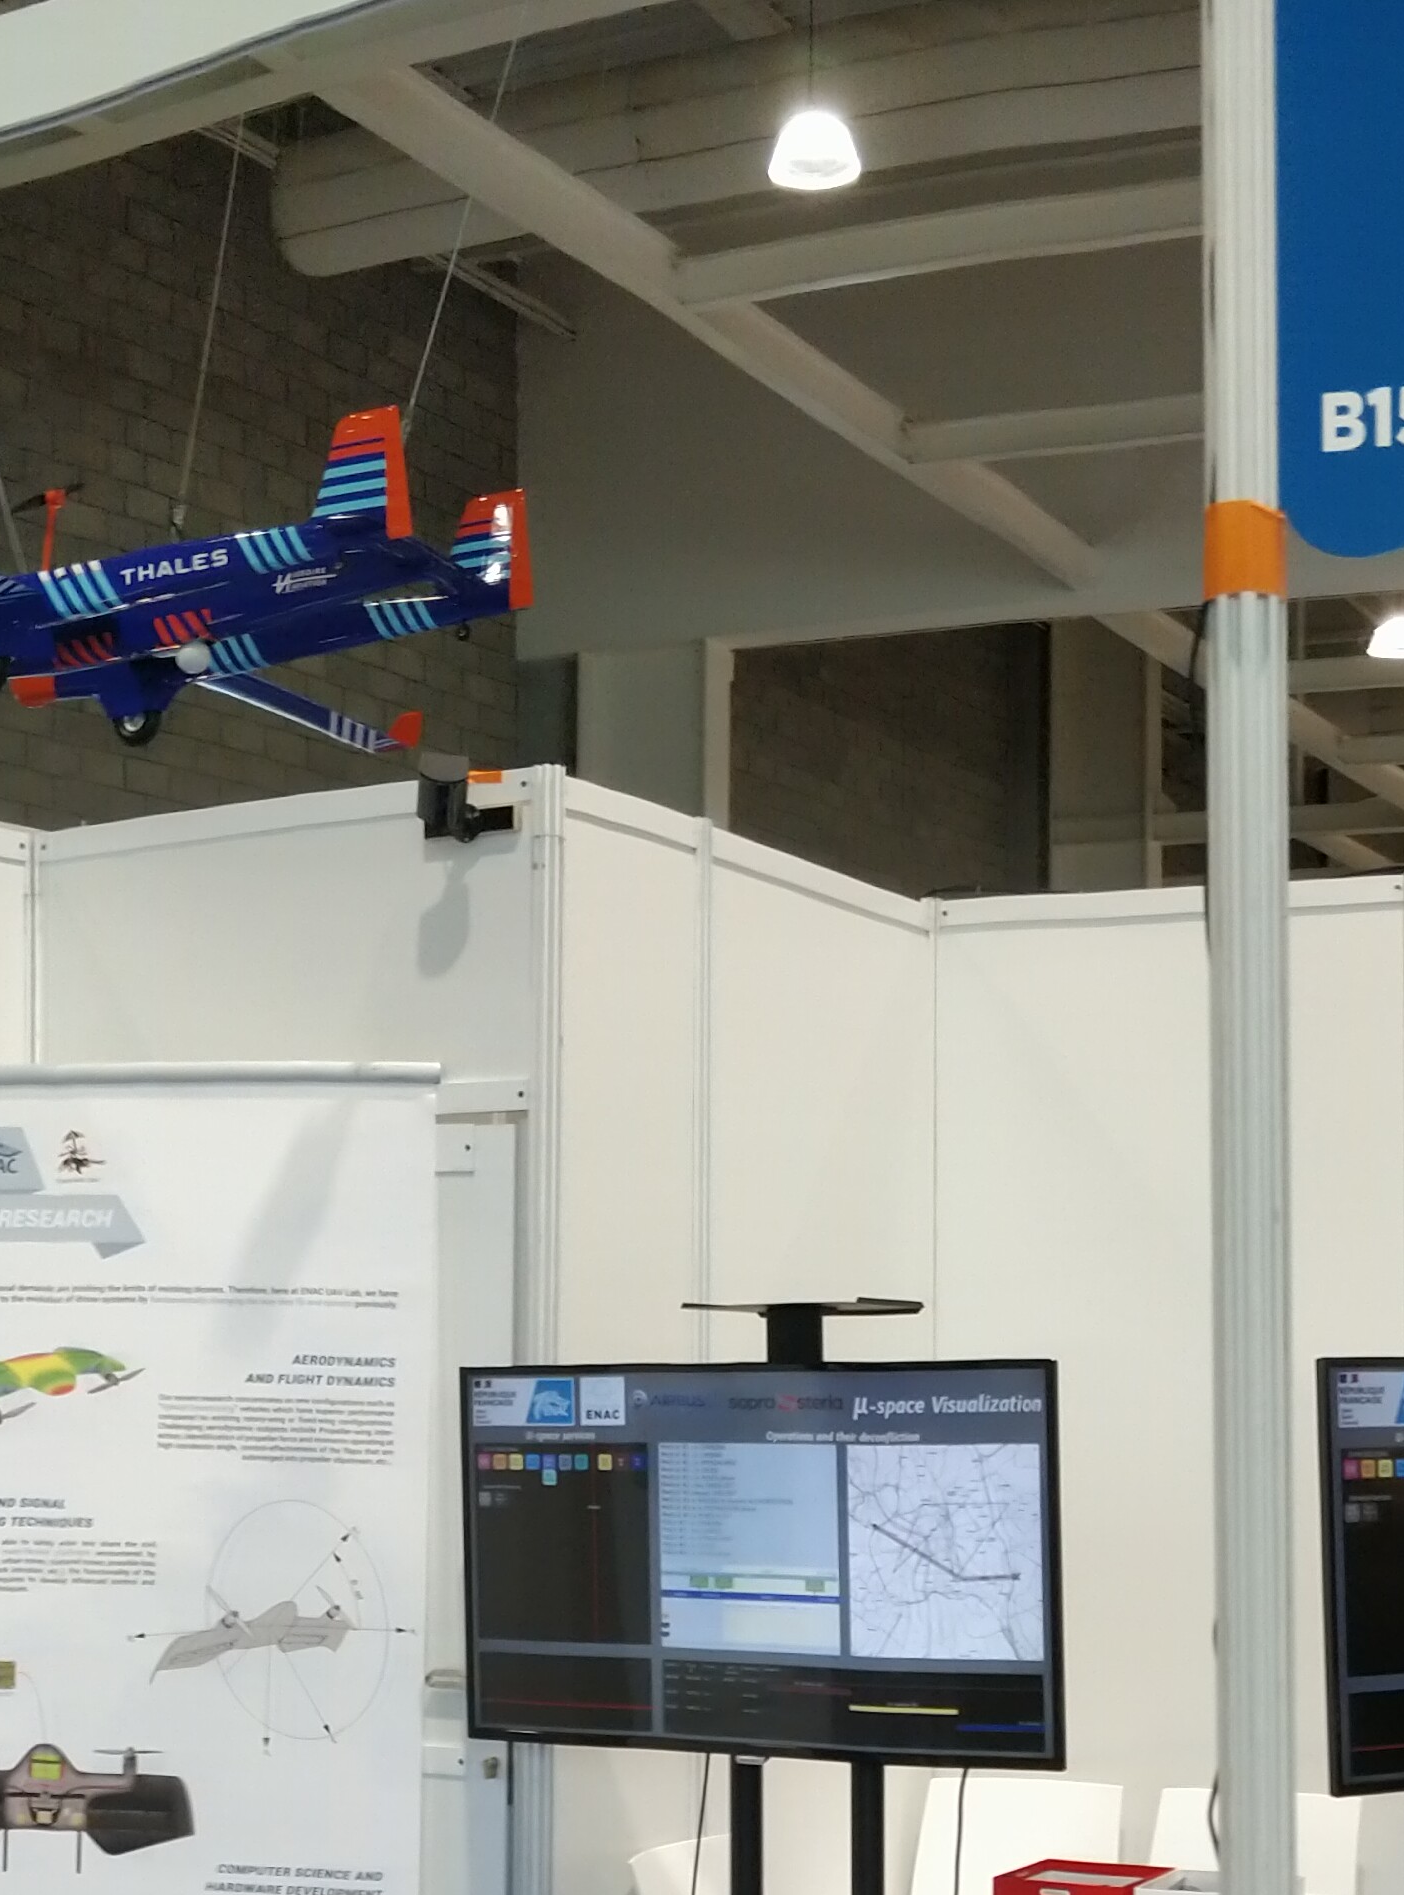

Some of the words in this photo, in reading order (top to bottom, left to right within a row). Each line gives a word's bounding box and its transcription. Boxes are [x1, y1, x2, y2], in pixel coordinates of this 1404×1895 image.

[119, 549, 229, 586] THALES
[292, 1354, 396, 1368] AERODYNAMICS
[245, 1373, 274, 1384] AND
[278, 1374, 323, 1386] FLIGHT
[326, 1376, 396, 1388] DYNAMICS
[931, 1392, 1043, 1415] Visualization
[585, 1409, 621, 1420] ENAC
[19, 1498, 67, 1510] SIGNAL
[11, 1516, 95, 1529] TECHNIQUES
[217, 1863, 291, 1877] COMPUTER
[295, 1867, 352, 1880] SCIENCE
[355, 1870, 384, 1882] AND
[204, 1882, 283, 1895] HARDWARE
